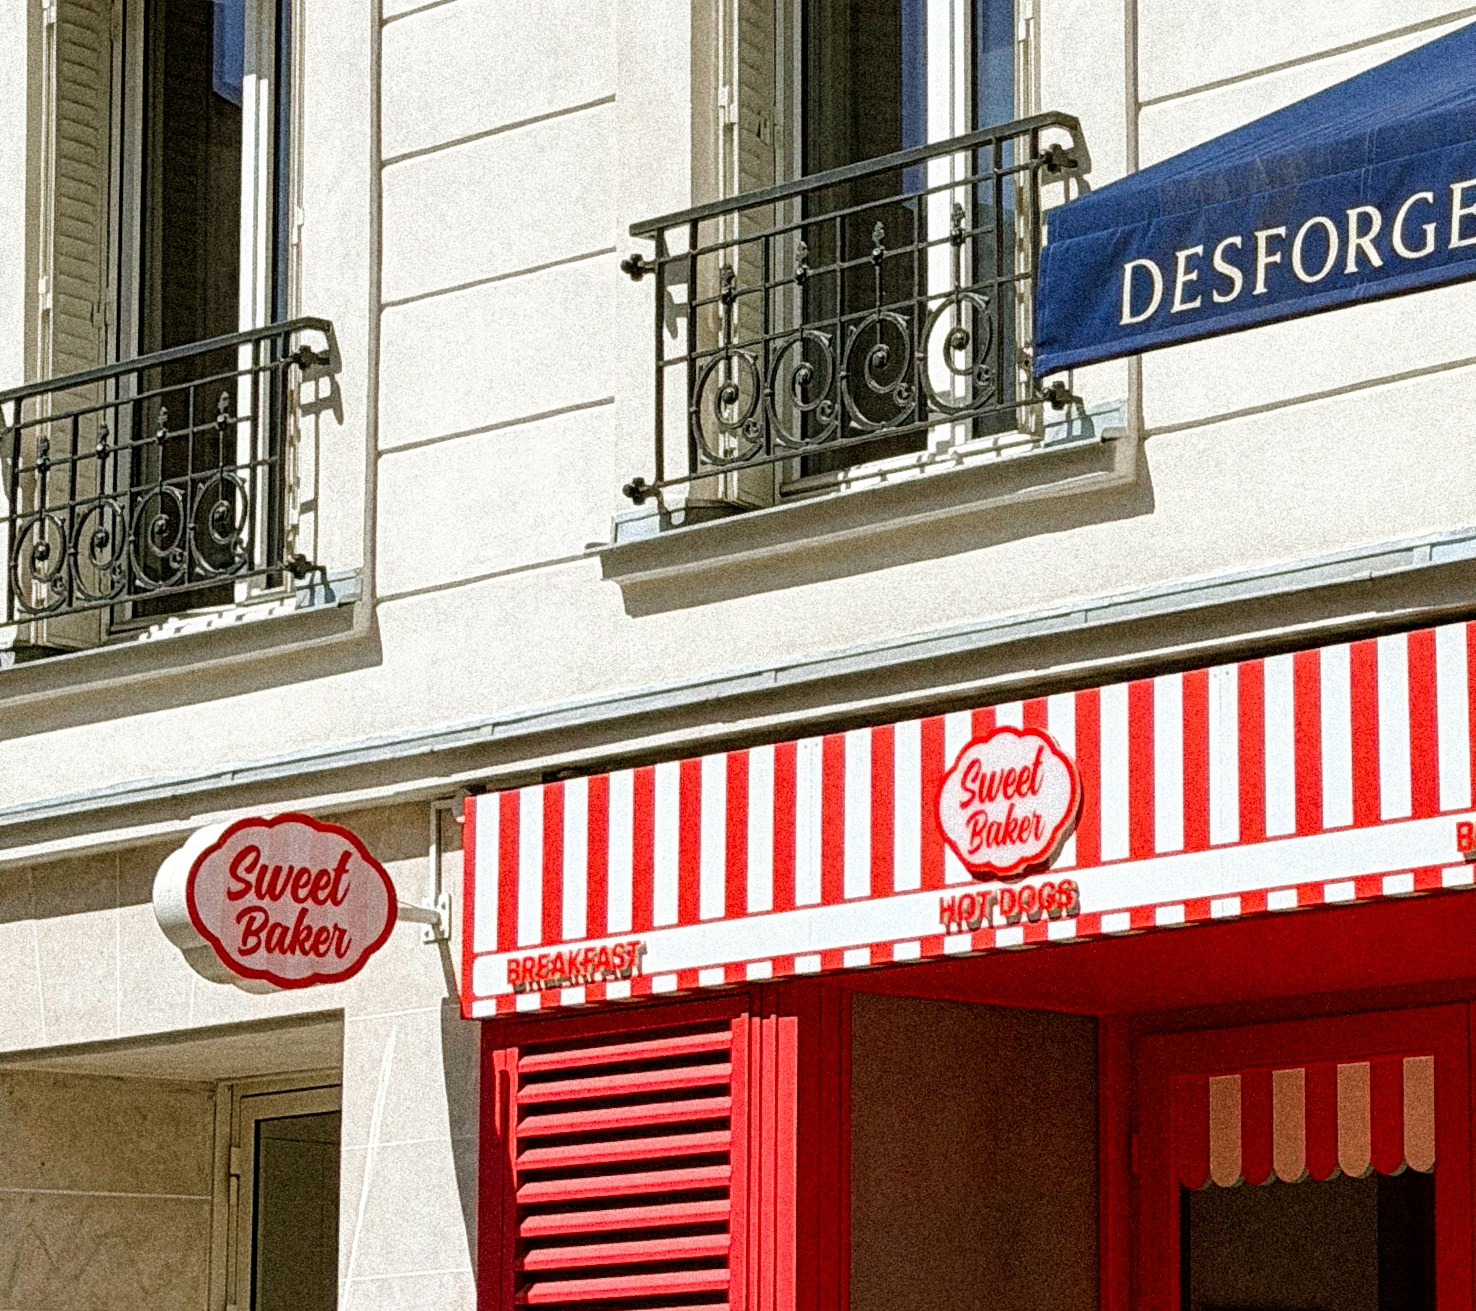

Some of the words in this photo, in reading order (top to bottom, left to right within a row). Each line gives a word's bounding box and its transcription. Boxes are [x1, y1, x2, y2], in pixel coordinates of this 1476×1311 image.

[959, 744, 1045, 810] Sweet
[965, 802, 1044, 855] Baker
[226, 844, 353, 907] Sweet
[939, 890, 993, 925] HOT
[999, 879, 1075, 916] DOGS
[235, 905, 352, 959] Baker
[507, 940, 642, 985] BREAKFAST
